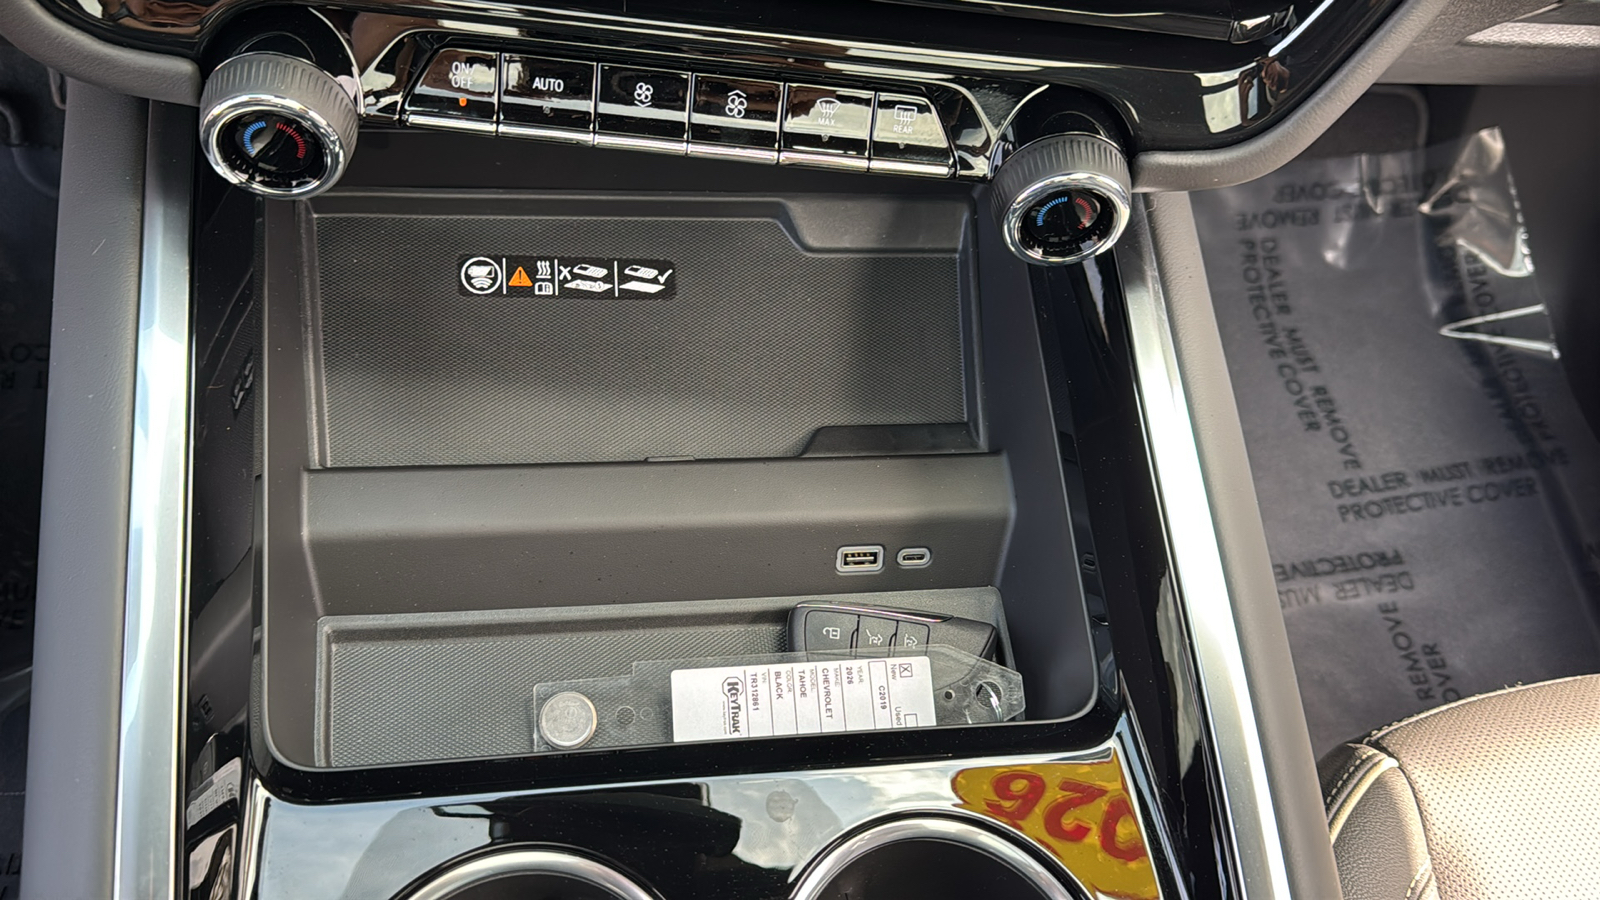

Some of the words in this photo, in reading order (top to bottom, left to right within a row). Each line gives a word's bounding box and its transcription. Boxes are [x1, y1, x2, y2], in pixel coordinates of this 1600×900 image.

[451, 61, 476, 76] ON/
[451, 74, 474, 89] OFF
[532, 76, 564, 92] AUTO
[817, 117, 836, 127] MAX
[893, 124, 913, 135] REAR
[1236, 207, 1320, 231] REMOVE
[1238, 238, 1287, 361] PROTECTIVE
[1276, 362, 1322, 433] COVER
[1260, 236, 1291, 317] DEALER
[1282, 325, 1320, 376] MUST
[1310, 384, 1363, 471] REMOVE
[1327, 470, 1411, 500] DEALER
[1419, 461, 1472, 483] MUST
[1337, 486, 1464, 523] PROTECTIVE
[1466, 476, 1540, 504] COVER
[1273, 549, 1406, 583] PROTECTIVE
[1335, 571, 1415, 602] DEALER
[1379, 600, 1435, 702] REMOVE
[774, 671, 784, 700] BLACK
[798, 669, 808, 699] TAHOE
[845, 667, 854, 685] 2026
[750, 672, 760, 711] TR312861
[821, 668, 833, 719] CHEVROLET
[878, 685, 888, 710] C2019
[890, 664, 898, 681] New
[894, 706, 903, 726] Used
